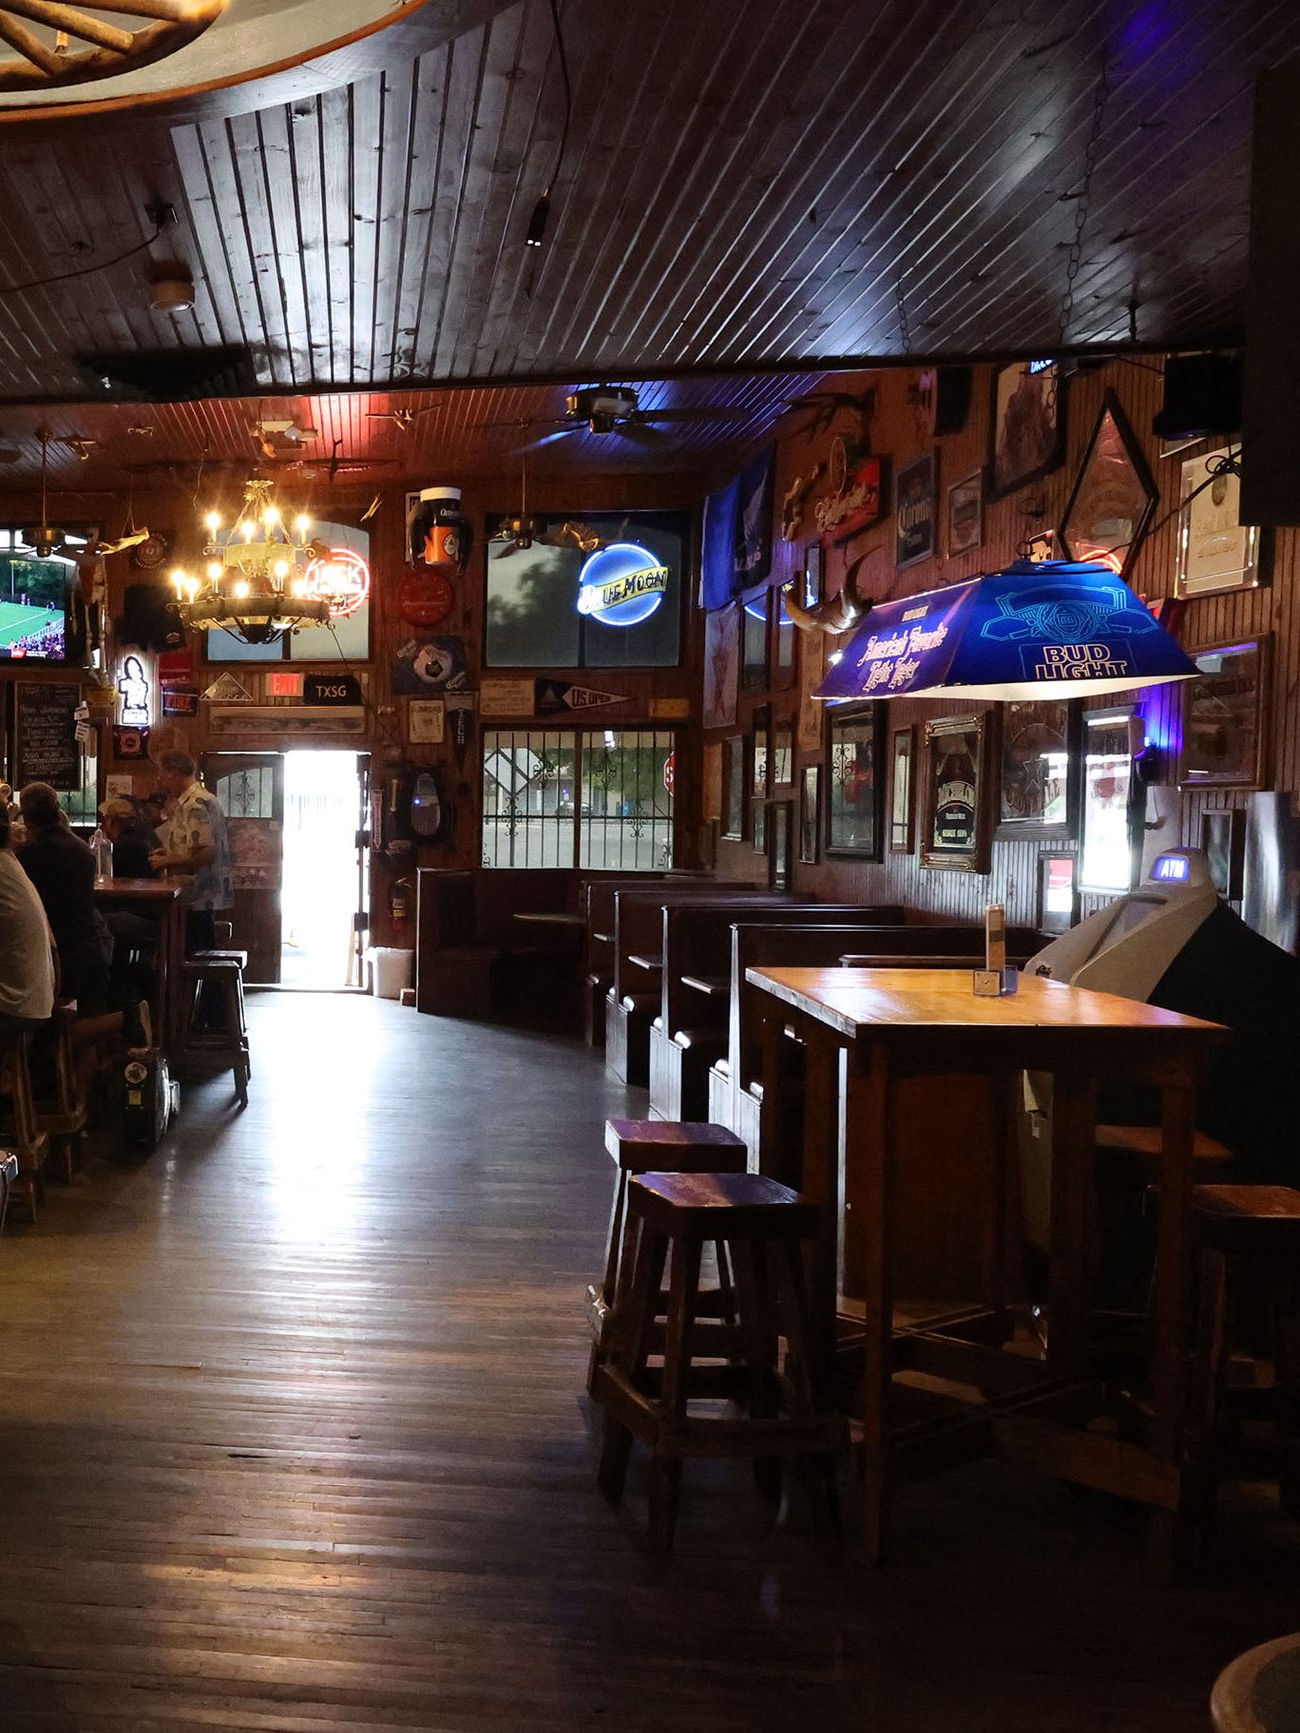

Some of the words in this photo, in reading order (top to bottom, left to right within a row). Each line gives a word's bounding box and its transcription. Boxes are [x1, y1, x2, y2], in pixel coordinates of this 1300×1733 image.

[622, 569, 668, 599] MOON
[856, 630, 909, 667] America's
[903, 622, 949, 661] Favorite
[1042, 643, 1111, 665] BUD
[861, 659, 894, 692] Light
[887, 657, 921, 689] Lager
[1035, 660, 1128, 680] LIGHT
[272, 674, 298, 695] EXIT
[316, 685, 347, 698] TXSG
[588, 689, 611, 704] OPEN
[1160, 859, 1185, 879] ATM
